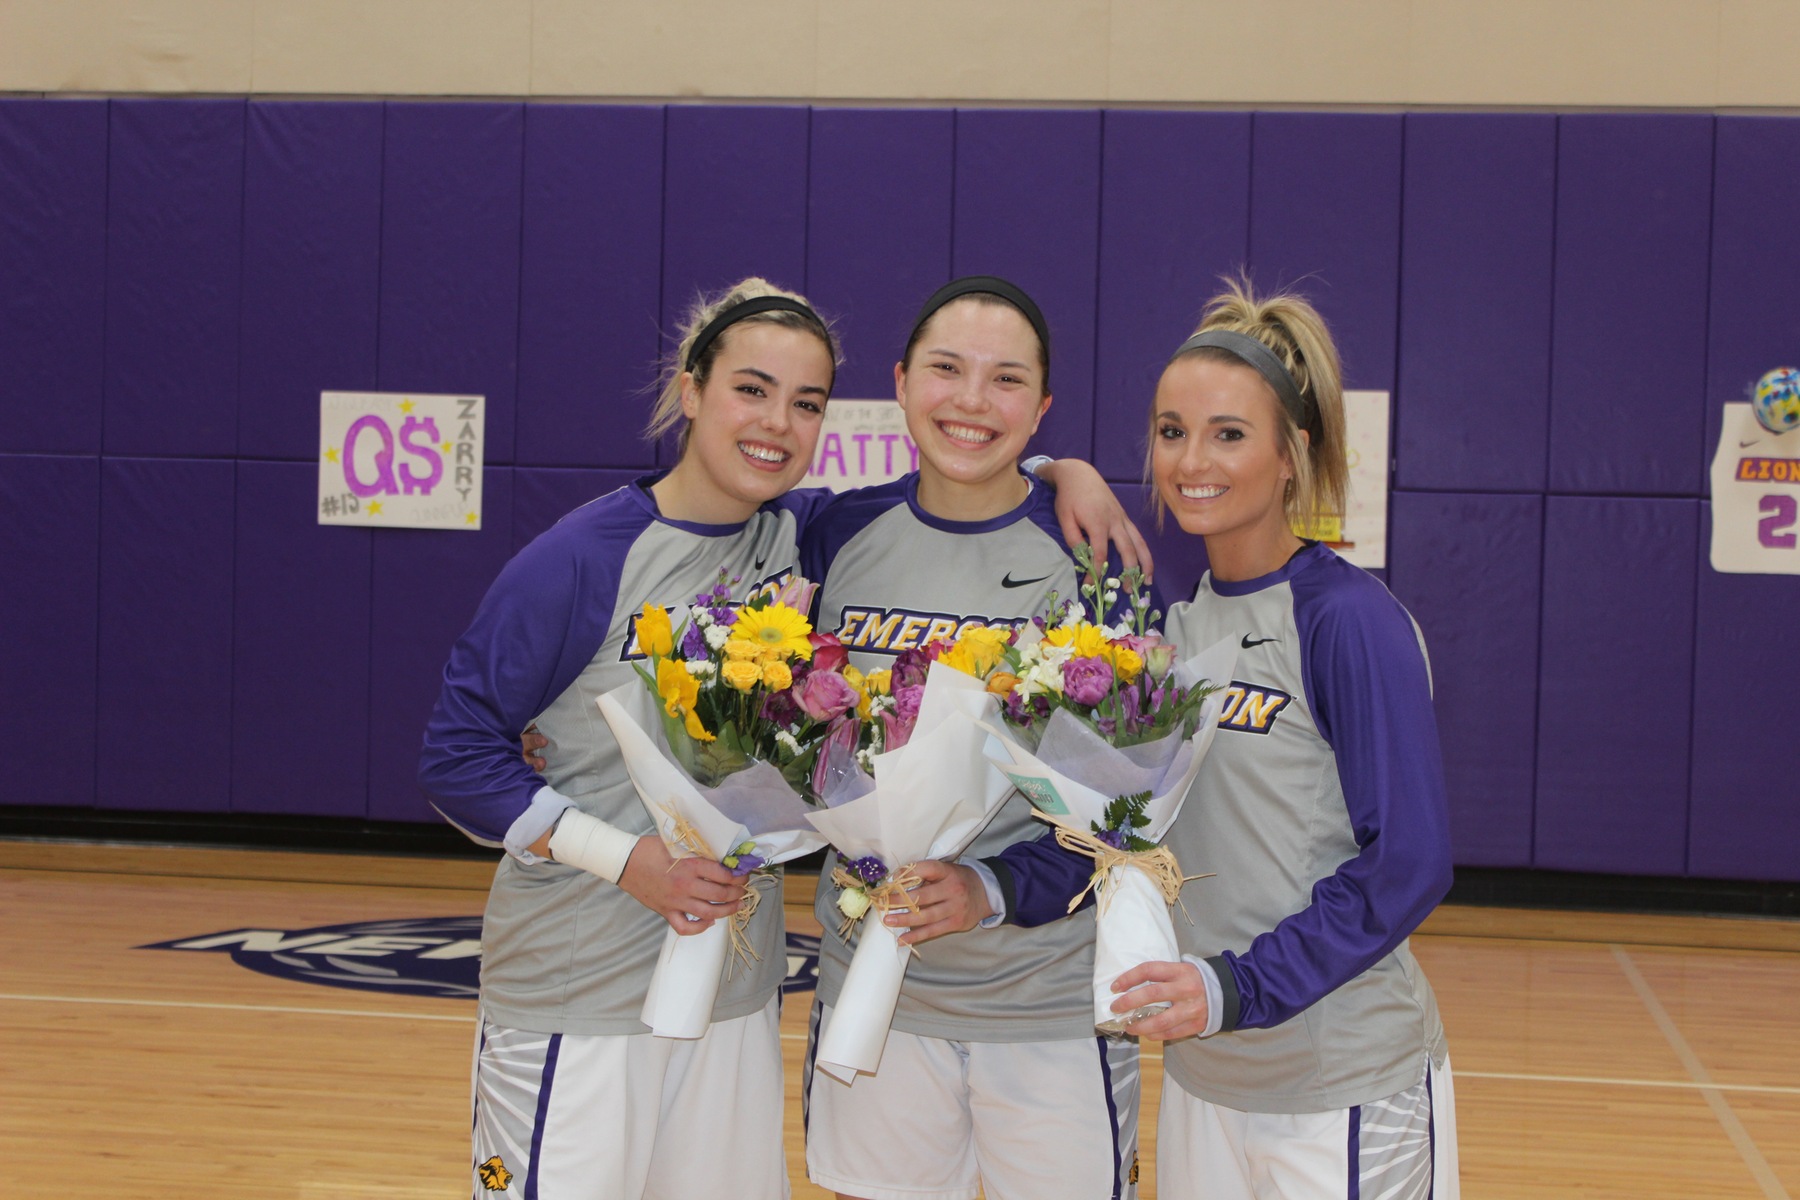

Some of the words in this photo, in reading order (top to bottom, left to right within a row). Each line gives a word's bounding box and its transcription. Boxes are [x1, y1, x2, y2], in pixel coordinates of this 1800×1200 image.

[455, 399, 478, 502] ZARRY
[808, 432, 919, 477] ATTY
[1758, 494, 1798, 550] 2
